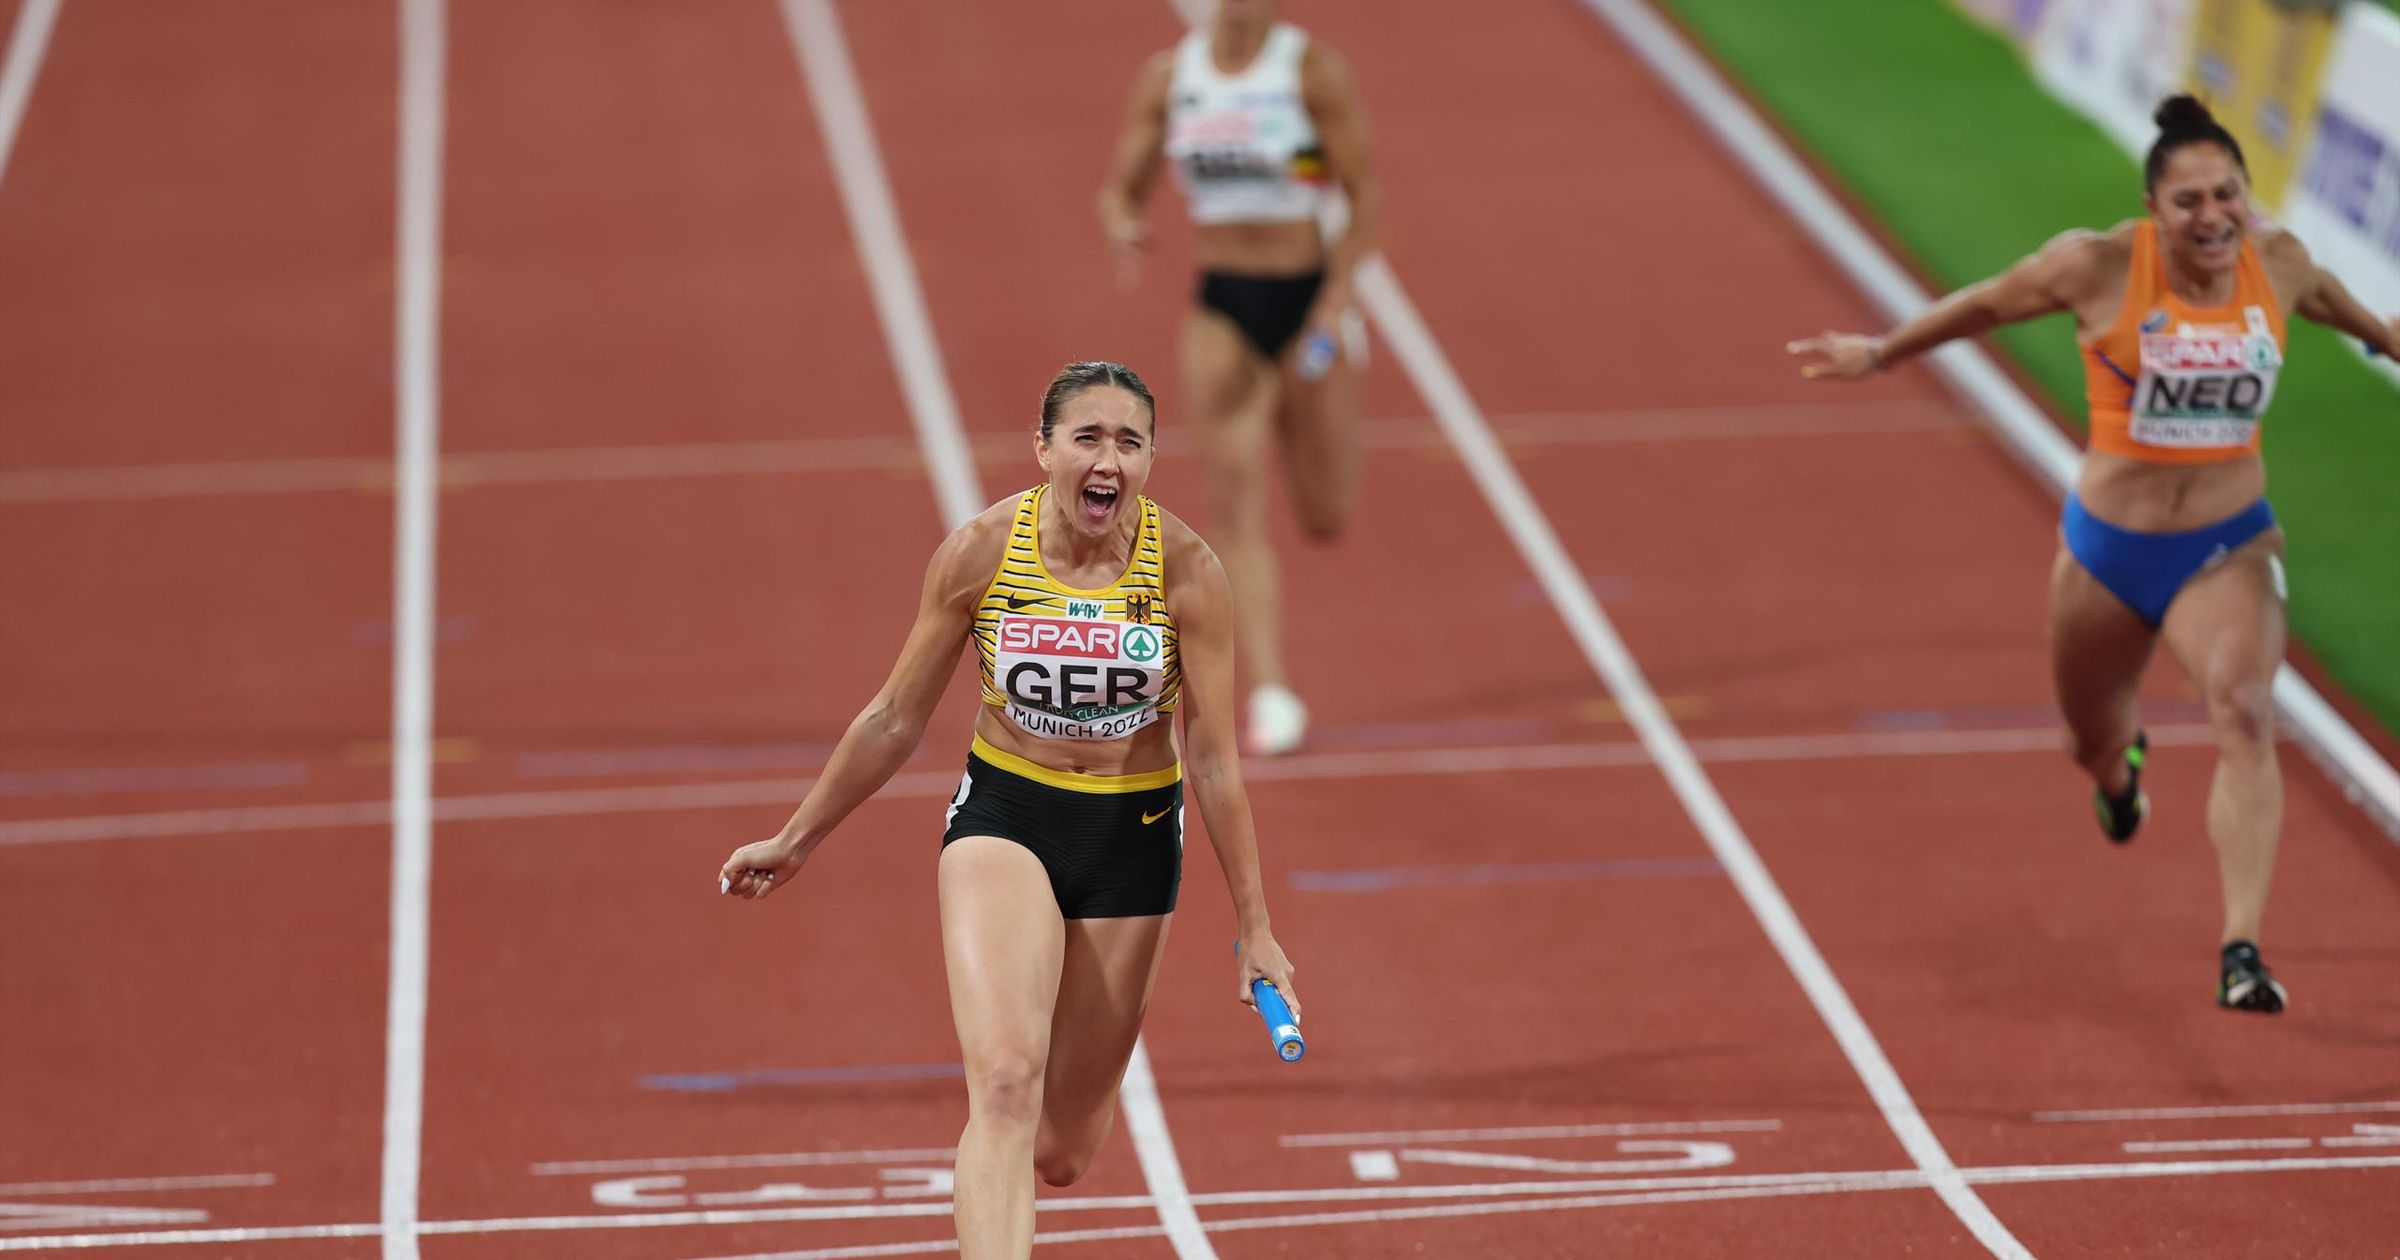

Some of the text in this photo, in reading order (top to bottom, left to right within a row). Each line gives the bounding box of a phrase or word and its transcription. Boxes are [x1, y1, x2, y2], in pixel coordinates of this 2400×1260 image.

[2149, 373, 2263, 412] NED
[1004, 622, 1117, 654] SPAR
[1005, 661, 1149, 710] GER
[1013, 707, 1149, 738] MUNICH 2022
[1076, 705, 1119, 721] CLEAN
